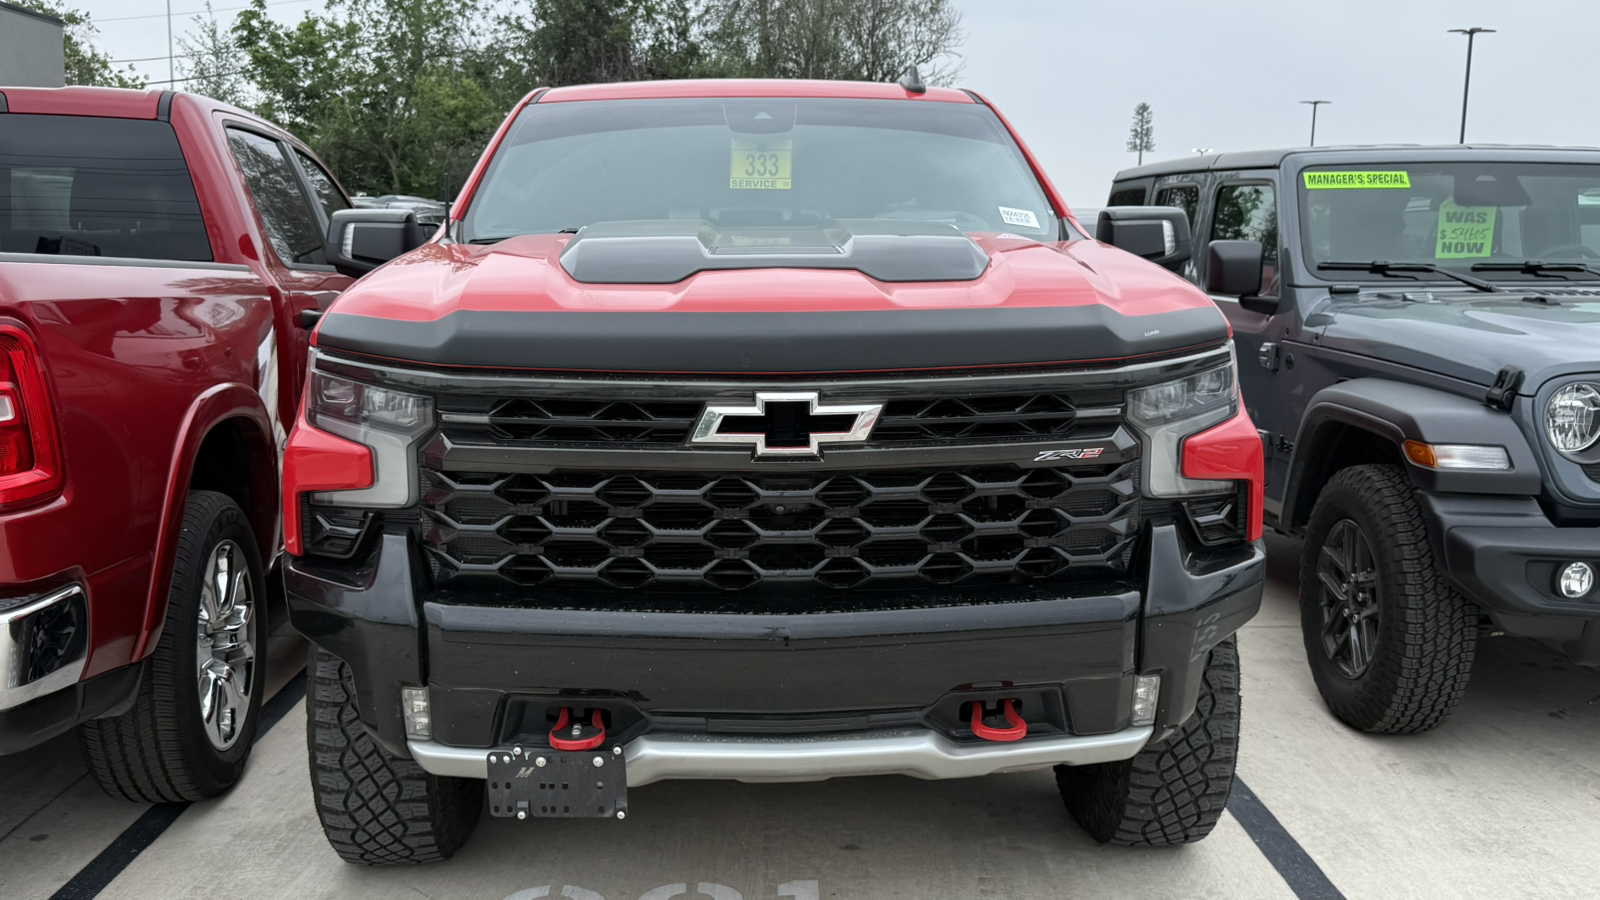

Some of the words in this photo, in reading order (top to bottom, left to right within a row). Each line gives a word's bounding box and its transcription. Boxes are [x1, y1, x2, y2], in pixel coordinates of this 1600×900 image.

[745, 153, 779, 177] 333
[731, 180, 777, 188] SERVICE
[1308, 174, 1363, 184] MANAGER'S
[1367, 173, 1405, 184] SPECIAL
[1445, 211, 1488, 224] WAS
[1441, 241, 1485, 254] NOW
[1033, 447, 1105, 462] ZR2
